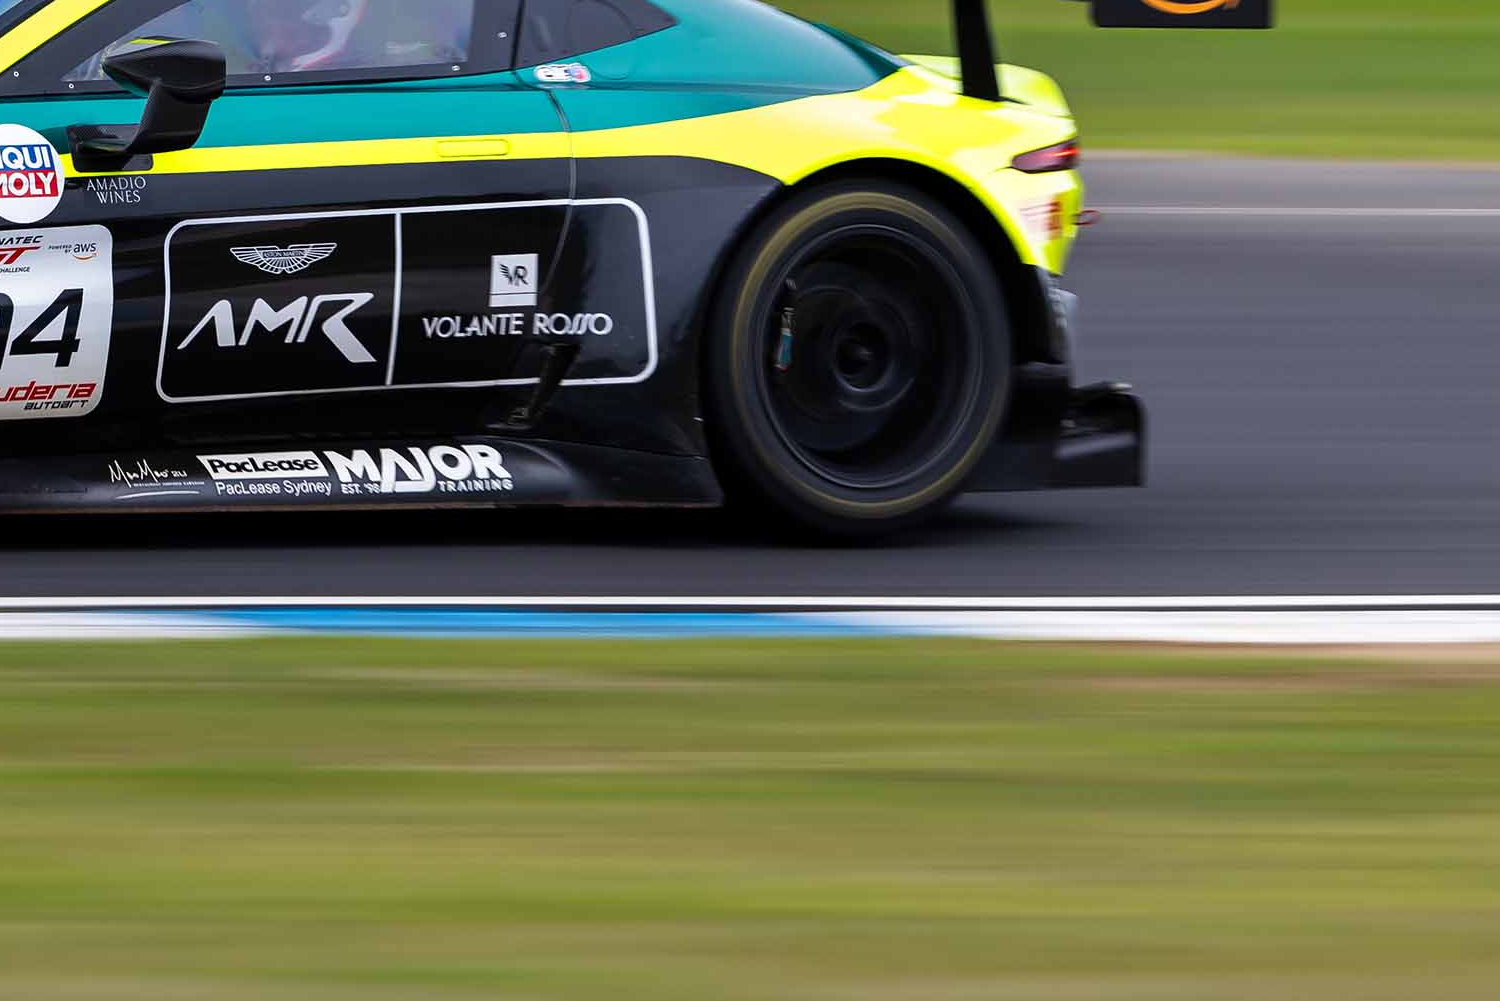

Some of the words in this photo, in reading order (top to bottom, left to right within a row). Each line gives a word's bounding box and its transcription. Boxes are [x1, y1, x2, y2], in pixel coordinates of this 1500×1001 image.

[87, 176, 146, 192] AMADIO
[96, 190, 141, 204] WINES
[74, 243, 96, 253] aws
[177, 292, 377, 364] AMR
[422, 313, 524, 338] VOLANTE
[532, 312, 614, 335] ROSSO
[207, 457, 319, 474] PacLease
[323, 444, 512, 493] MAJOR
[215, 481, 281, 495] PacLease
[283, 479, 331, 497] Sydney
[437, 478, 514, 493] TRAINING
